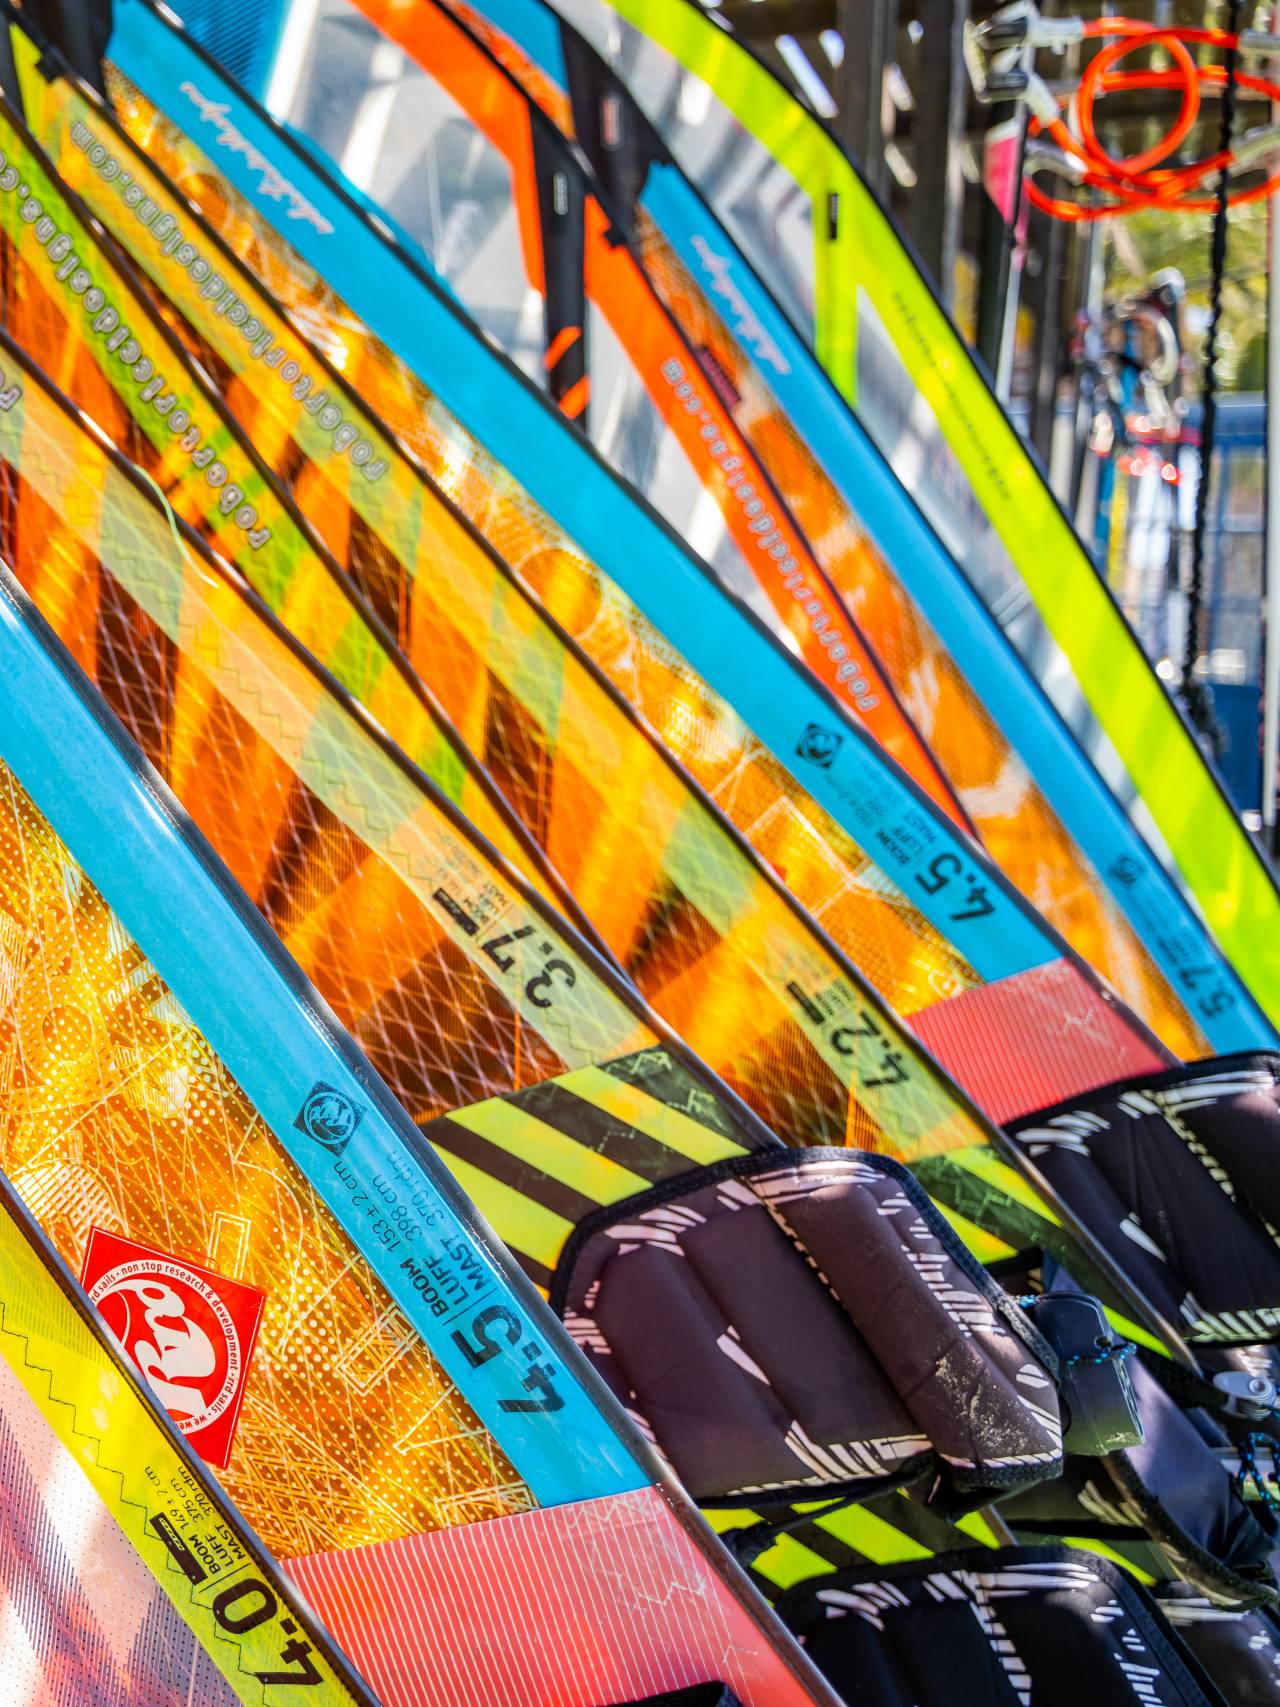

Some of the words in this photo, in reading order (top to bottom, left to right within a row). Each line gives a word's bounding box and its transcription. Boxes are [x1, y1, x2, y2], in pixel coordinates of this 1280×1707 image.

[914, 853, 995, 921] 4.5
[481, 925, 576, 1008] 3.7
[831, 1010, 909, 1087] 4.2
[333, 1161, 357, 1192] cm
[388, 1151, 421, 1191] rdm
[352, 1192, 368, 1208] 2
[374, 1174, 399, 1205] cm
[413, 1189, 444, 1226] 370
[372, 1220, 402, 1252] 153
[390, 1205, 423, 1243] 398
[121, 1264, 139, 1275] non
[142, 1261, 163, 1273] stop
[165, 1265, 205, 1293] research
[423, 1252, 469, 1305] LUFF
[440, 1237, 491, 1292] MAST
[99, 1275, 116, 1292] sails
[205, 1290, 214, 1299] &
[399, 1257, 449, 1318] BOOM
[212, 1299, 238, 1370] development
[451, 1303, 565, 1413] 4.5
[223, 1377, 237, 1394] rrd
[195, 1414, 208, 1423] we
[211, 1394, 229, 1414] sails
[178, 1421, 192, 1430] we
[145, 1466, 161, 1487] cm
[158, 1487, 167, 1497] 2
[170, 1478, 187, 1498] cm
[178, 1465, 203, 1495] rdm
[170, 1509, 188, 1529] 149
[183, 1501, 204, 1523] 375
[194, 1493, 215, 1516] 370
[188, 1533, 221, 1575] BOOM
[204, 1533, 234, 1567] LUFF
[215, 1523, 246, 1560] MAST
[212, 1578, 324, 1686] 4.0
